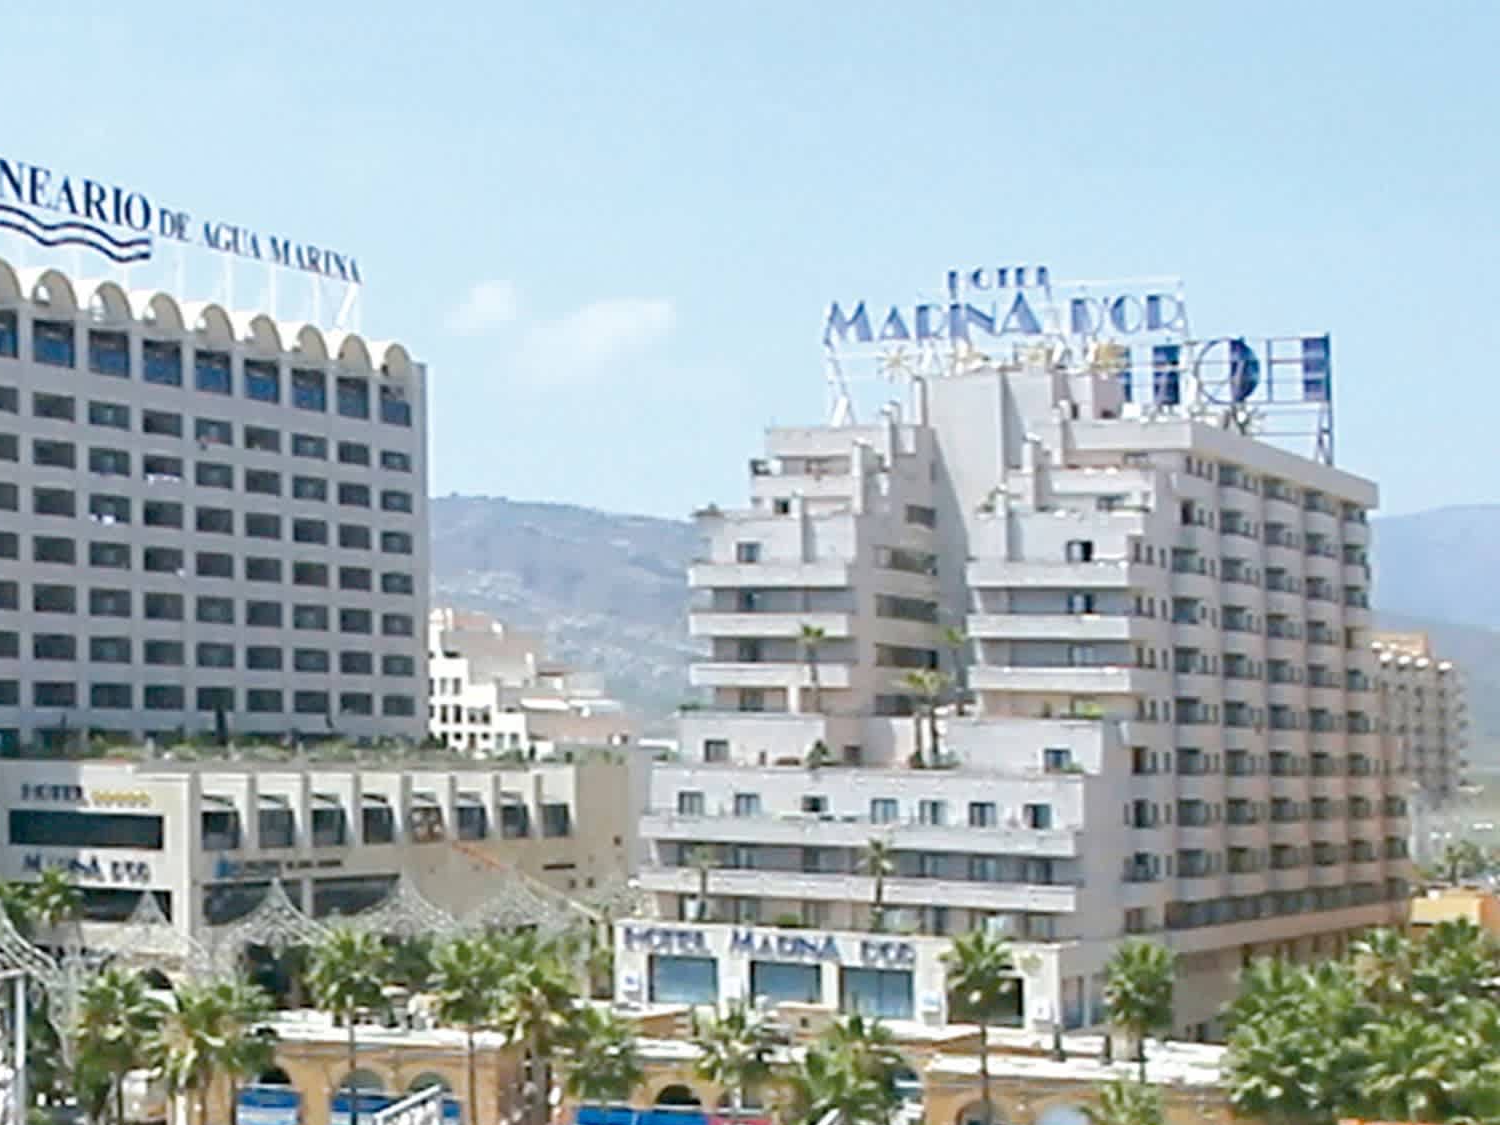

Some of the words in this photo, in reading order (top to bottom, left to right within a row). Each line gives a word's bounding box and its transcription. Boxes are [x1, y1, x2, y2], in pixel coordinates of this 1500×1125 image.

[159, 207, 191, 243] DE
[199, 221, 261, 260] AGUA
[265, 236, 363, 284] MARINA
[823, 291, 1042, 345] MARINA
